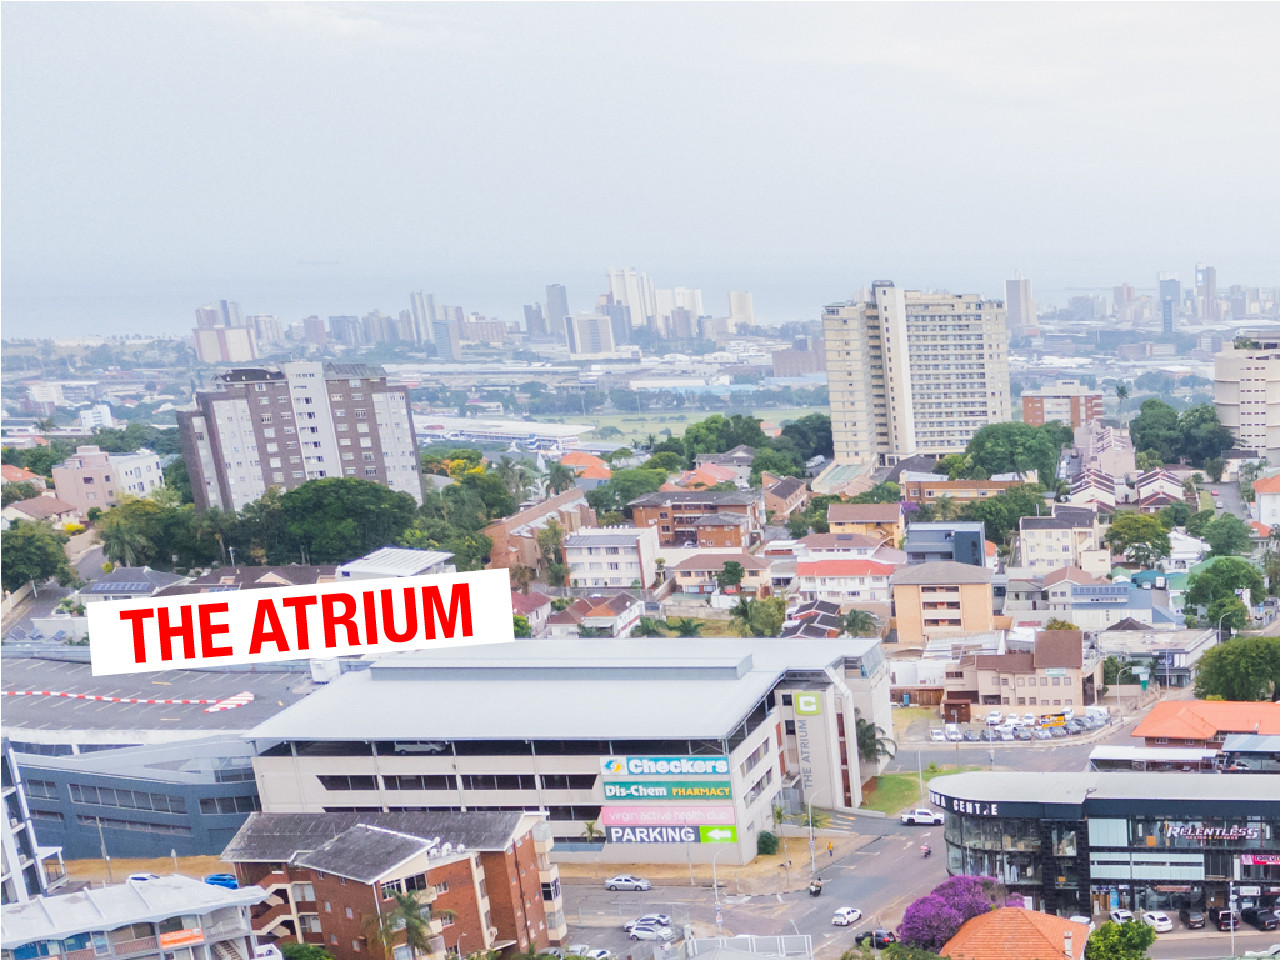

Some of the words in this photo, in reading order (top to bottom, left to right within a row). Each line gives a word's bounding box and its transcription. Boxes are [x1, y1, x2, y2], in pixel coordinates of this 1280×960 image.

[797, 719, 811, 763] ATRIUM
[628, 759, 728, 773] Checkers
[802, 767, 813, 790] THE
[604, 785, 667, 796] Dis-Chem
[672, 786, 730, 796] PHARMACY
[609, 811, 638, 821] virgin
[640, 809, 672, 820] active
[674, 808, 705, 820] health
[706, 809, 729, 820] club
[610, 827, 696, 842] PARKING
[1166, 826, 1260, 838] RELENTLESS
